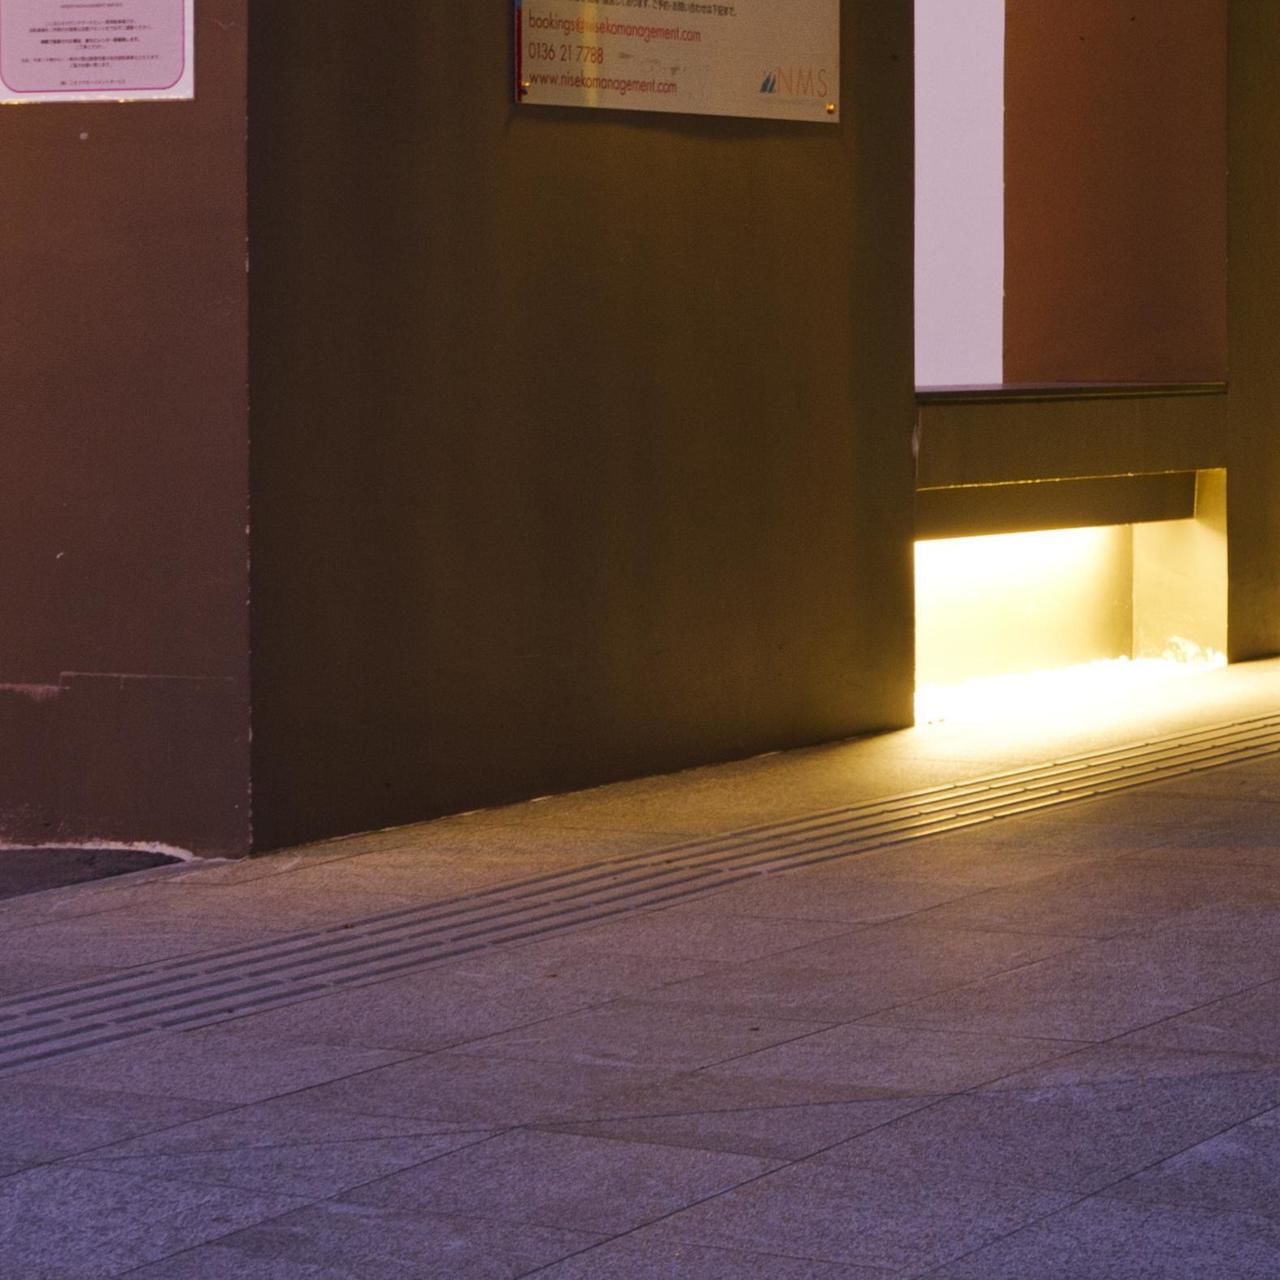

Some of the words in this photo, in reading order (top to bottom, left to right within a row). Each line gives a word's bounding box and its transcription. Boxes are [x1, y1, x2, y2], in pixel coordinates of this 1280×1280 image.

[528, 9, 701, 43] bookings@nisekomanagement.com
[528, 42, 556, 61] 0136
[560, 44, 572, 62] 21
[576, 45, 604, 65] 7788
[529, 70, 677, 96] www.nisekomanagement.com
[777, 66, 828, 98] NMS
